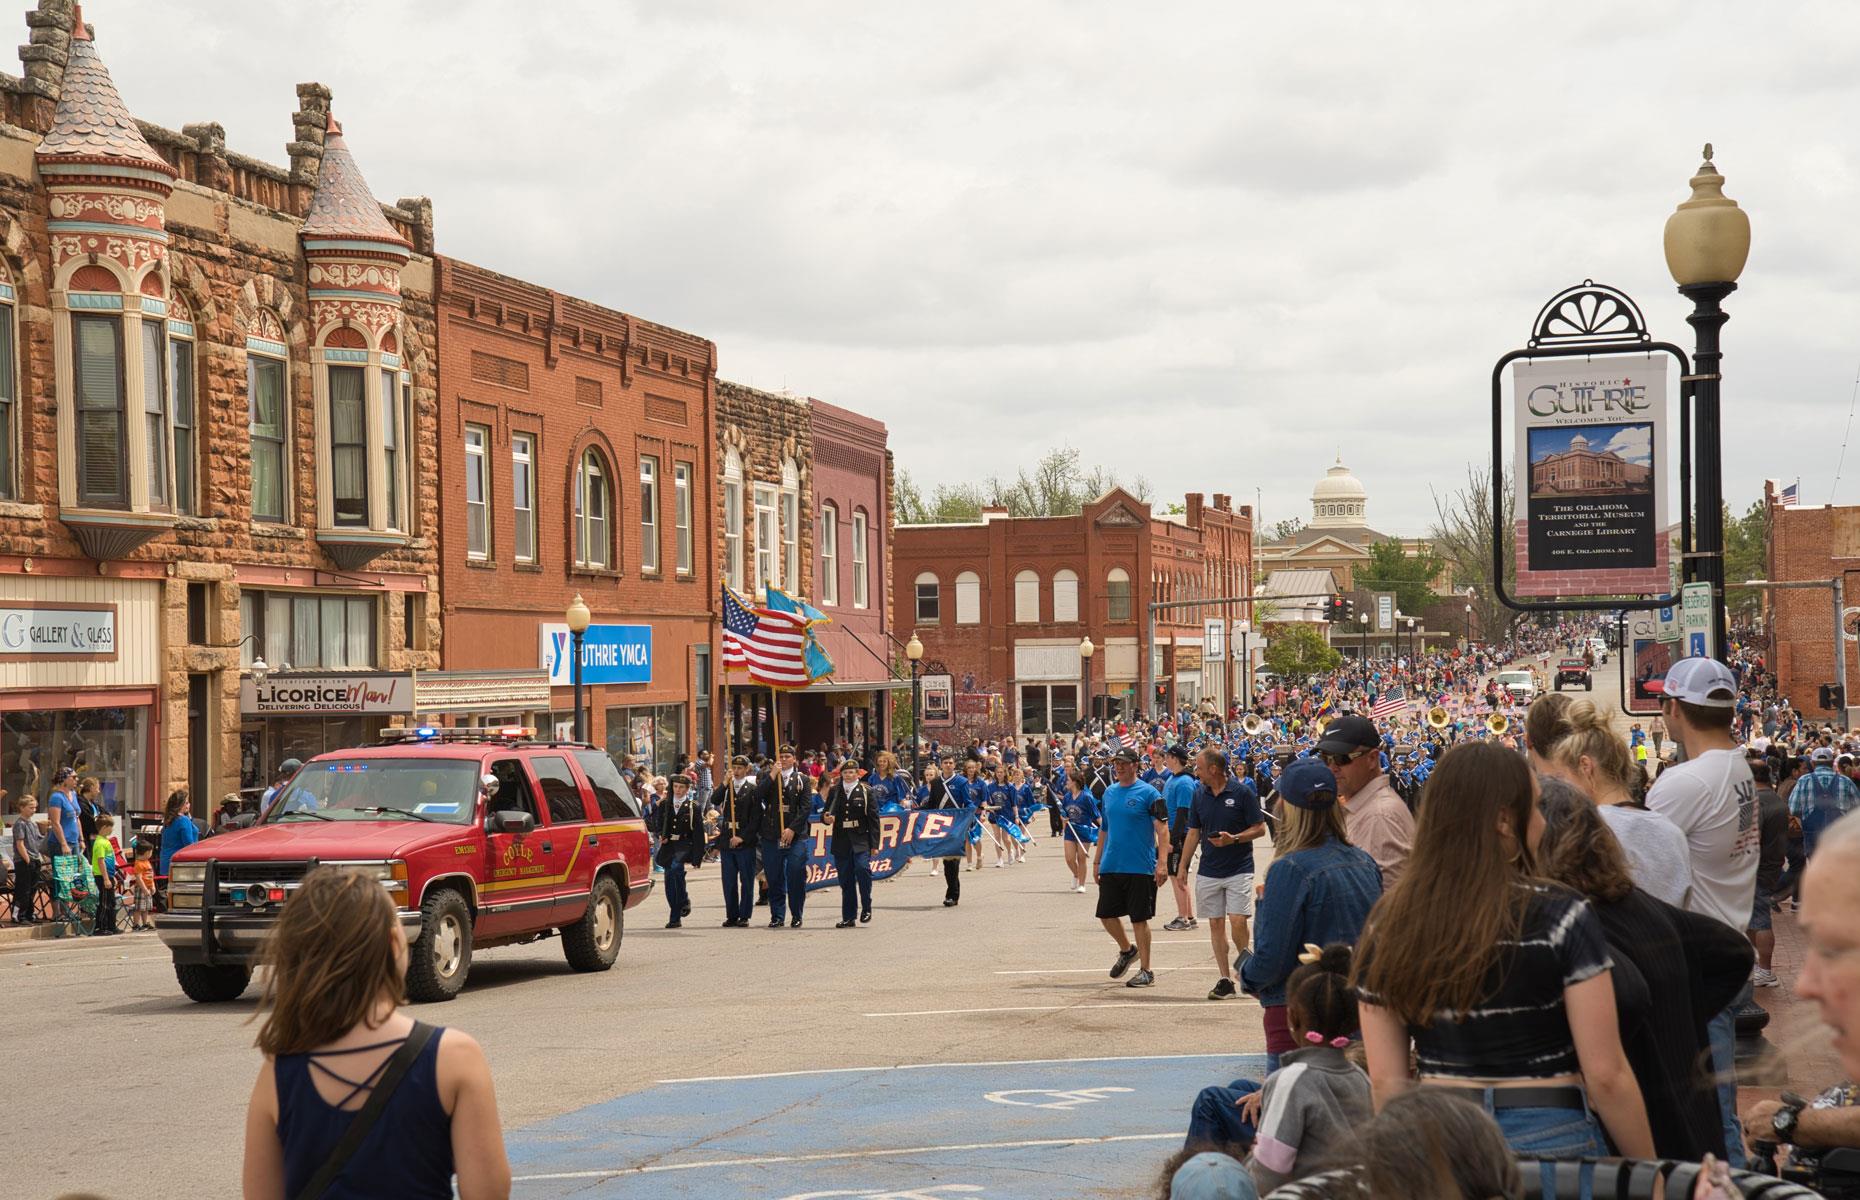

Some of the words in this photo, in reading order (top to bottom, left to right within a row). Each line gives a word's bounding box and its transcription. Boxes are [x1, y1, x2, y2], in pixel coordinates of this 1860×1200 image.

[1560, 379, 1621, 388] HISTORIC
[1527, 384, 1652, 417] GUTHRIE
[1555, 417, 1604, 425] WELCOMES
[1576, 503, 1629, 512] OKLAHOMA
[1537, 513, 1601, 521] TERRITORIAL
[1603, 511, 1645, 519] MUSEUM
[1546, 529, 1594, 537] CARNEGIE
[1596, 528, 1637, 536] LIBRARY
[29, 626, 68, 644] GALLERY
[71, 622, 86, 648] &
[87, 627, 112, 644] GLASS
[581, 643, 619, 667] UTHRIE
[619, 643, 648, 666] YMCA
[345, 679, 396, 711] Man!
[257, 703, 311, 711] DELIVERING
[314, 702, 361, 711] DELICIOUS
[809, 812, 954, 857] TRIE
[503, 843, 534, 866] COYLE
